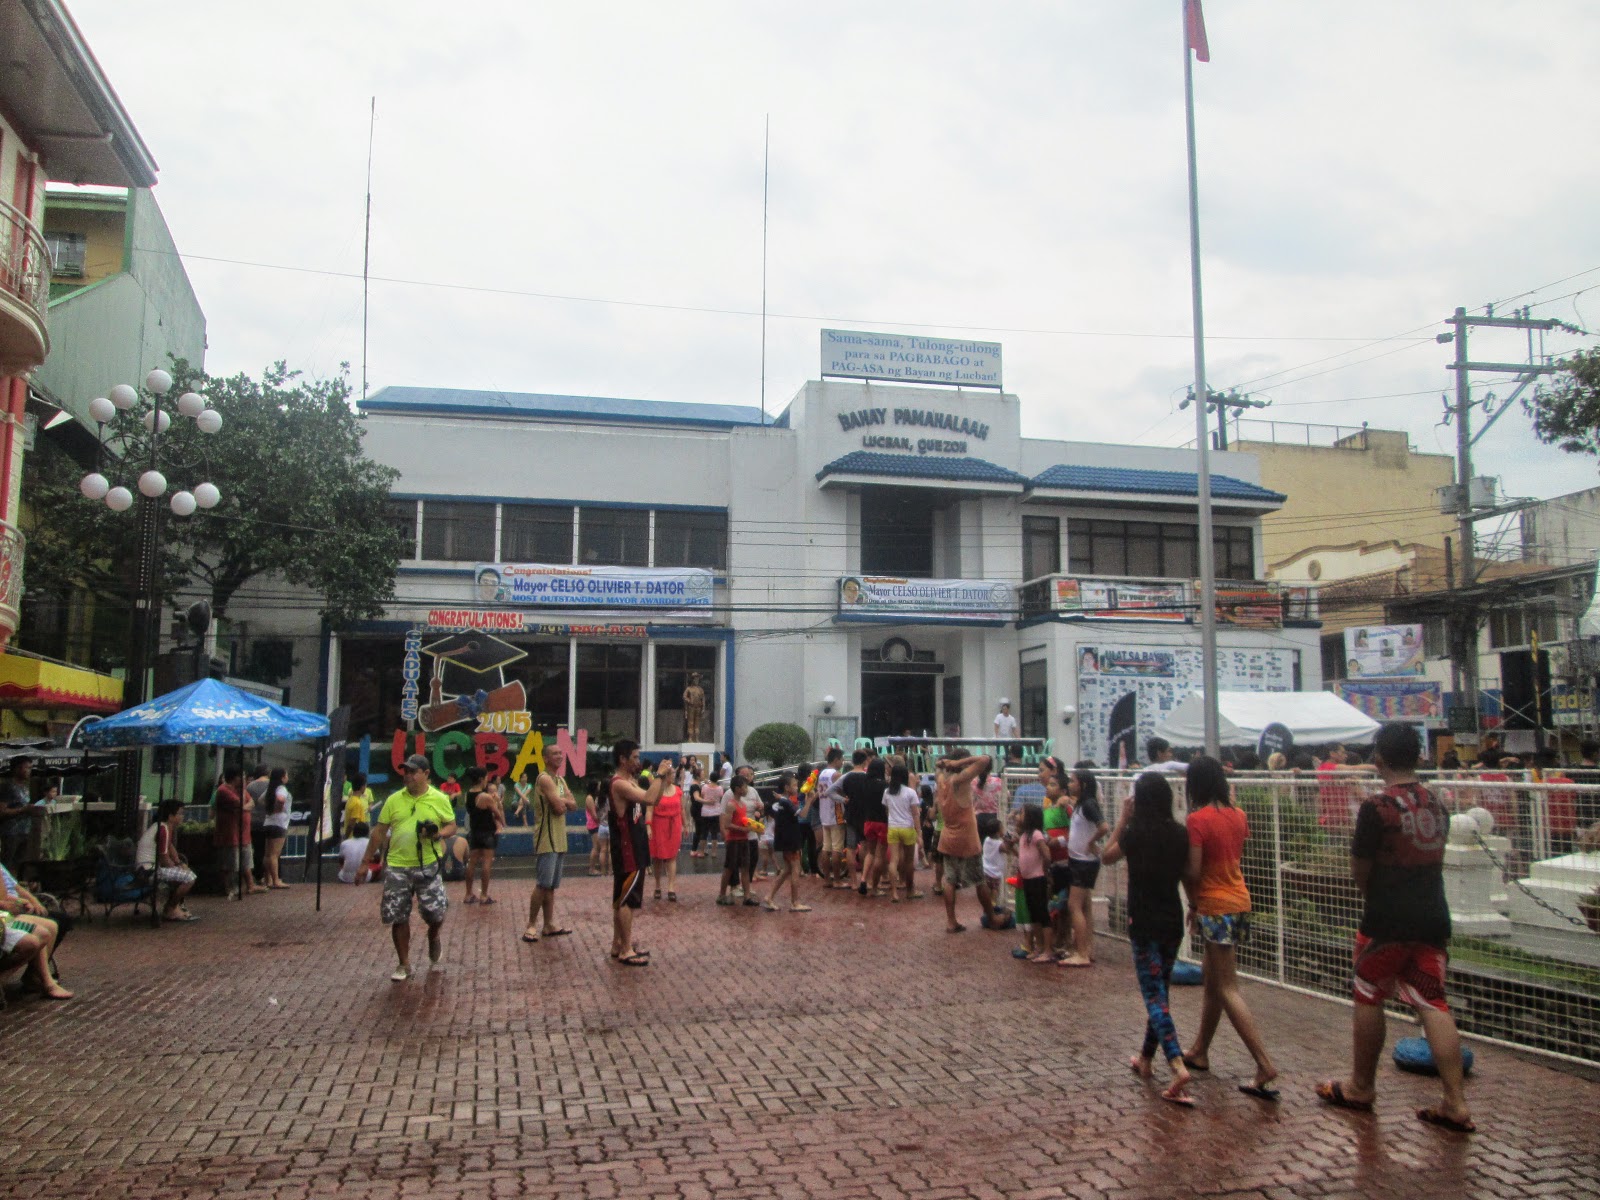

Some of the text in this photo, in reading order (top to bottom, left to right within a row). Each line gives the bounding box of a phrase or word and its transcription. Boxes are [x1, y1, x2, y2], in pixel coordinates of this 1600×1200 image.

[828, 331, 1000, 358] Sama-sama, Tulong-tulong
[844, 351, 870, 360] para
[890, 352, 970, 366] PAGBABAGO
[973, 359, 985, 367] at
[831, 361, 997, 381] PAG-ASA ng Bayan ng Lucban!
[837, 407, 991, 441] BAHAY PAMAHALAAN
[862, 435, 968, 454] LUCBAN, QUEZON
[503, 566, 592, 577] Congratulations!
[513, 578, 685, 595] Mayor CELSO OLIVIER T. DATOR
[868, 584, 891, 598] Mayor
[892, 585, 918, 598] CELSO
[920, 586, 952, 599] OLIVIER
[962, 588, 989, 601] DATOR
[512, 594, 538, 602] MOST
[540, 595, 604, 603] OUTSTANDING
[607, 596, 637, 604] MAYOR
[427, 609, 524, 629] CONGRATULATIONS!
[568, 624, 648, 637] PAG-ASA
[402, 630, 421, 720] GRADUATES
[475, 711, 532, 735] 2015
[358, 728, 589, 785] LUCBAN
